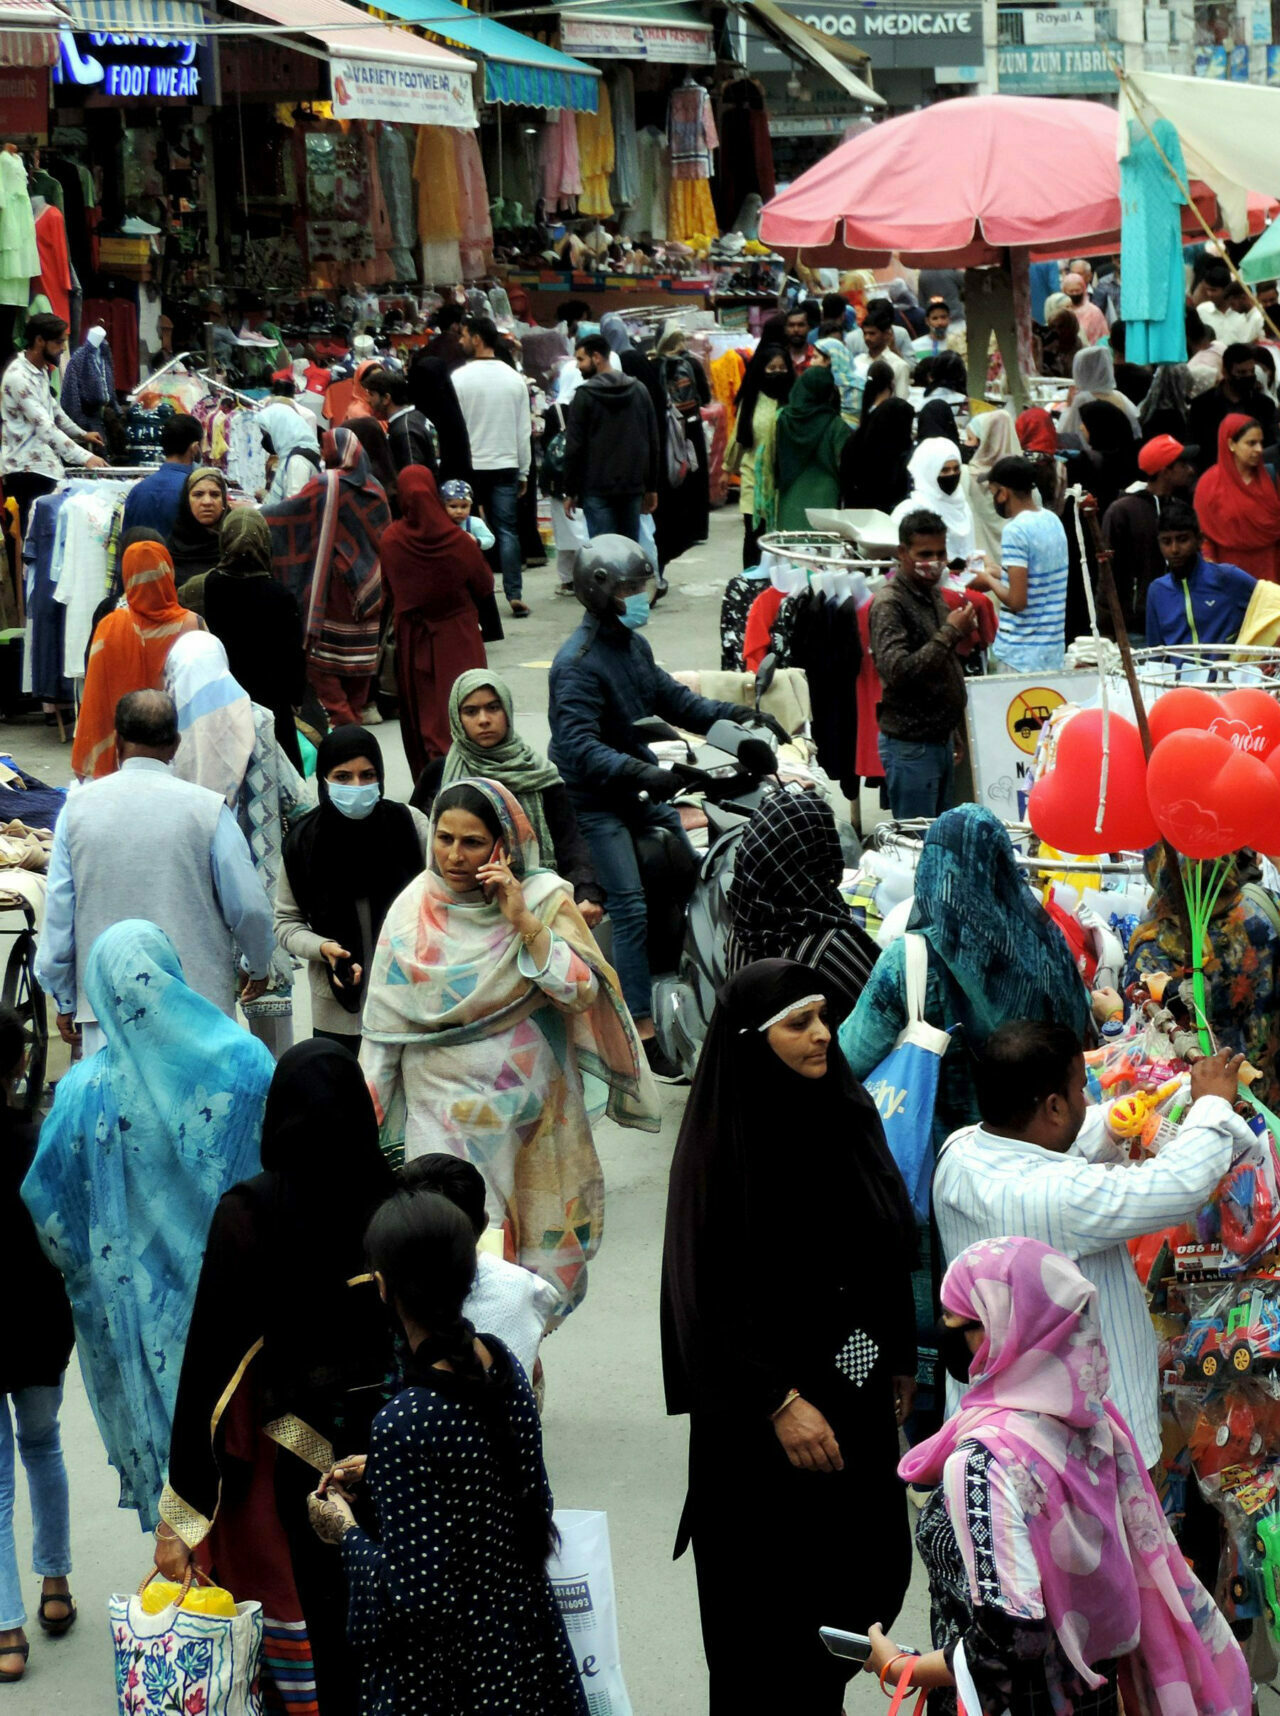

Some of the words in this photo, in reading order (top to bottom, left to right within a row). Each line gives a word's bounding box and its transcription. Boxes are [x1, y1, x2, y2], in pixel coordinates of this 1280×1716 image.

[864, 12, 972, 35] MEDICATE
[1036, 12, 1071, 26] Royal
[1000, 52, 1027, 73] ZUM
[1031, 51, 1062, 73] ZUM
[1065, 50, 1124, 73] FABRICS
[108, 65, 150, 96] FOOT
[154, 66, 199, 96] WEAR
[353, 65, 397, 87] VARIETY
[399, 70, 450, 92] FOOTWEAR
